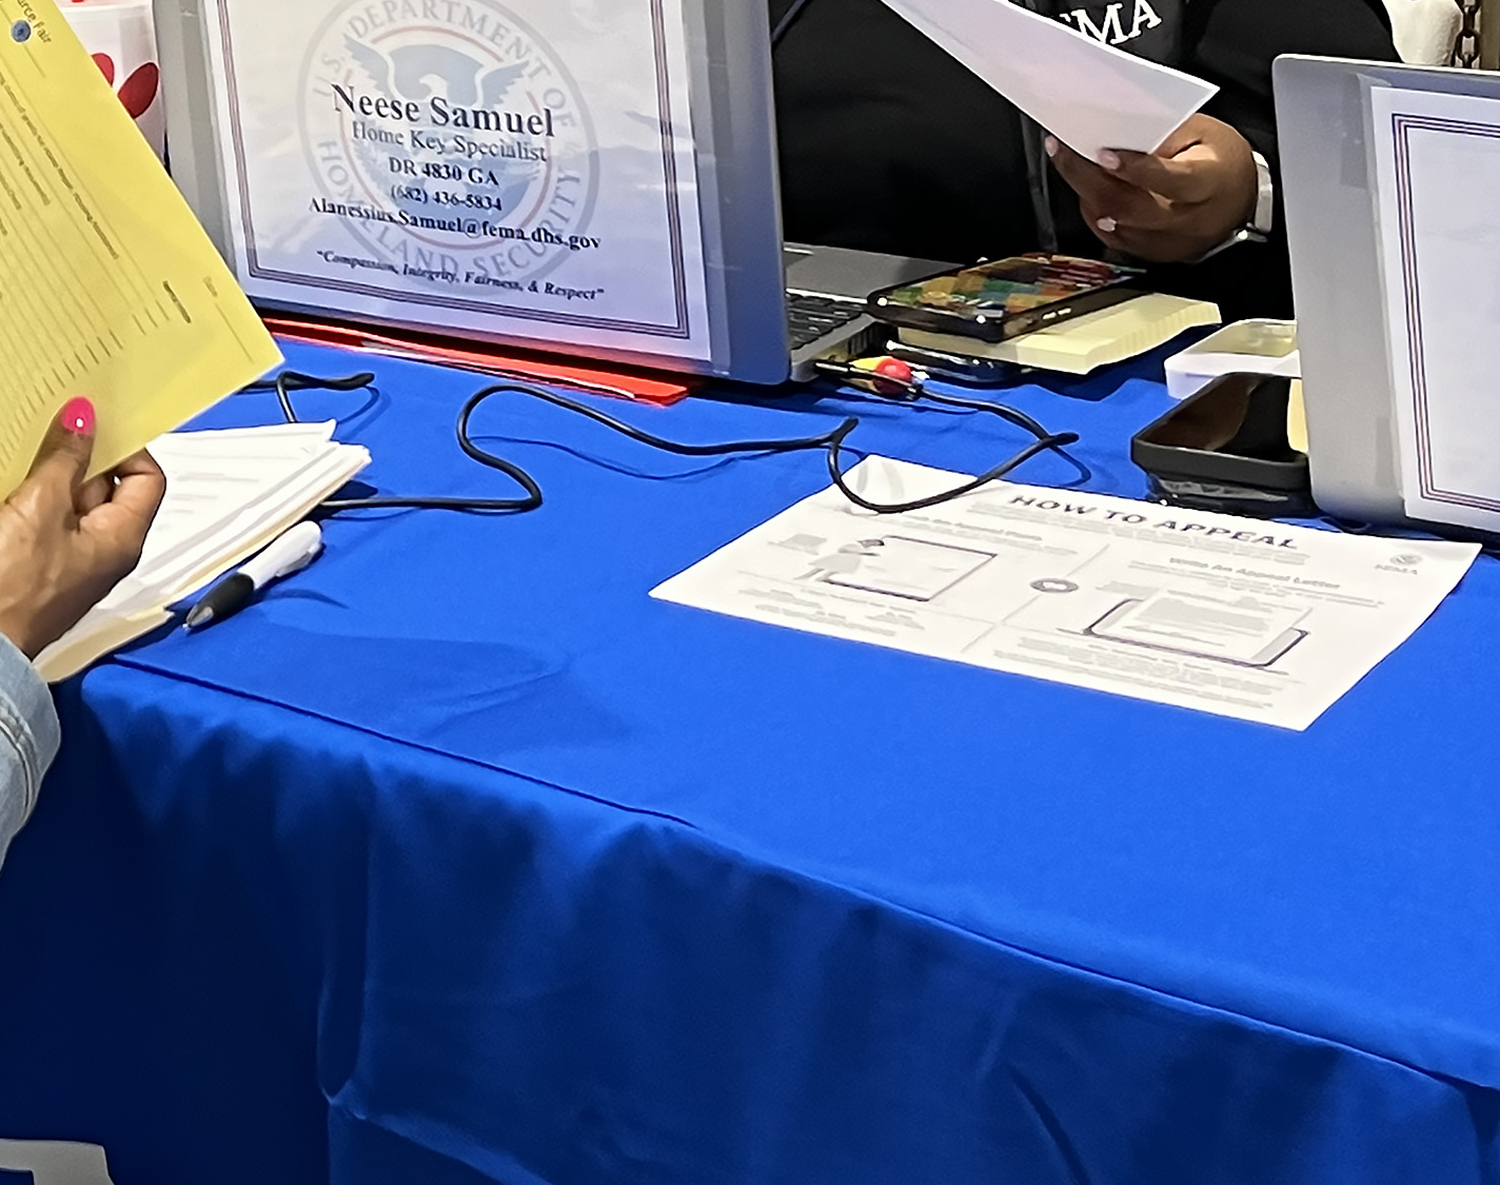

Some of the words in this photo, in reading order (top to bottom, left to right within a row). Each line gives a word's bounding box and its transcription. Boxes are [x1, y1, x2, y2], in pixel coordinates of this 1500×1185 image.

[331, 83, 420, 123] Neese
[430, 96, 555, 138] Samuel
[352, 121, 404, 145] Home
[410, 129, 446, 155] Key
[454, 134, 548, 162] Specialist
[389, 157, 417, 175] DR
[421, 162, 462, 181] 4830
[468, 167, 500, 186] GA
[434, 190, 502, 211] 436-5834
[1008, 494, 1097, 515] HOW
[1103, 509, 1147, 524] TO
[1153, 519, 1299, 550] APPEAL
